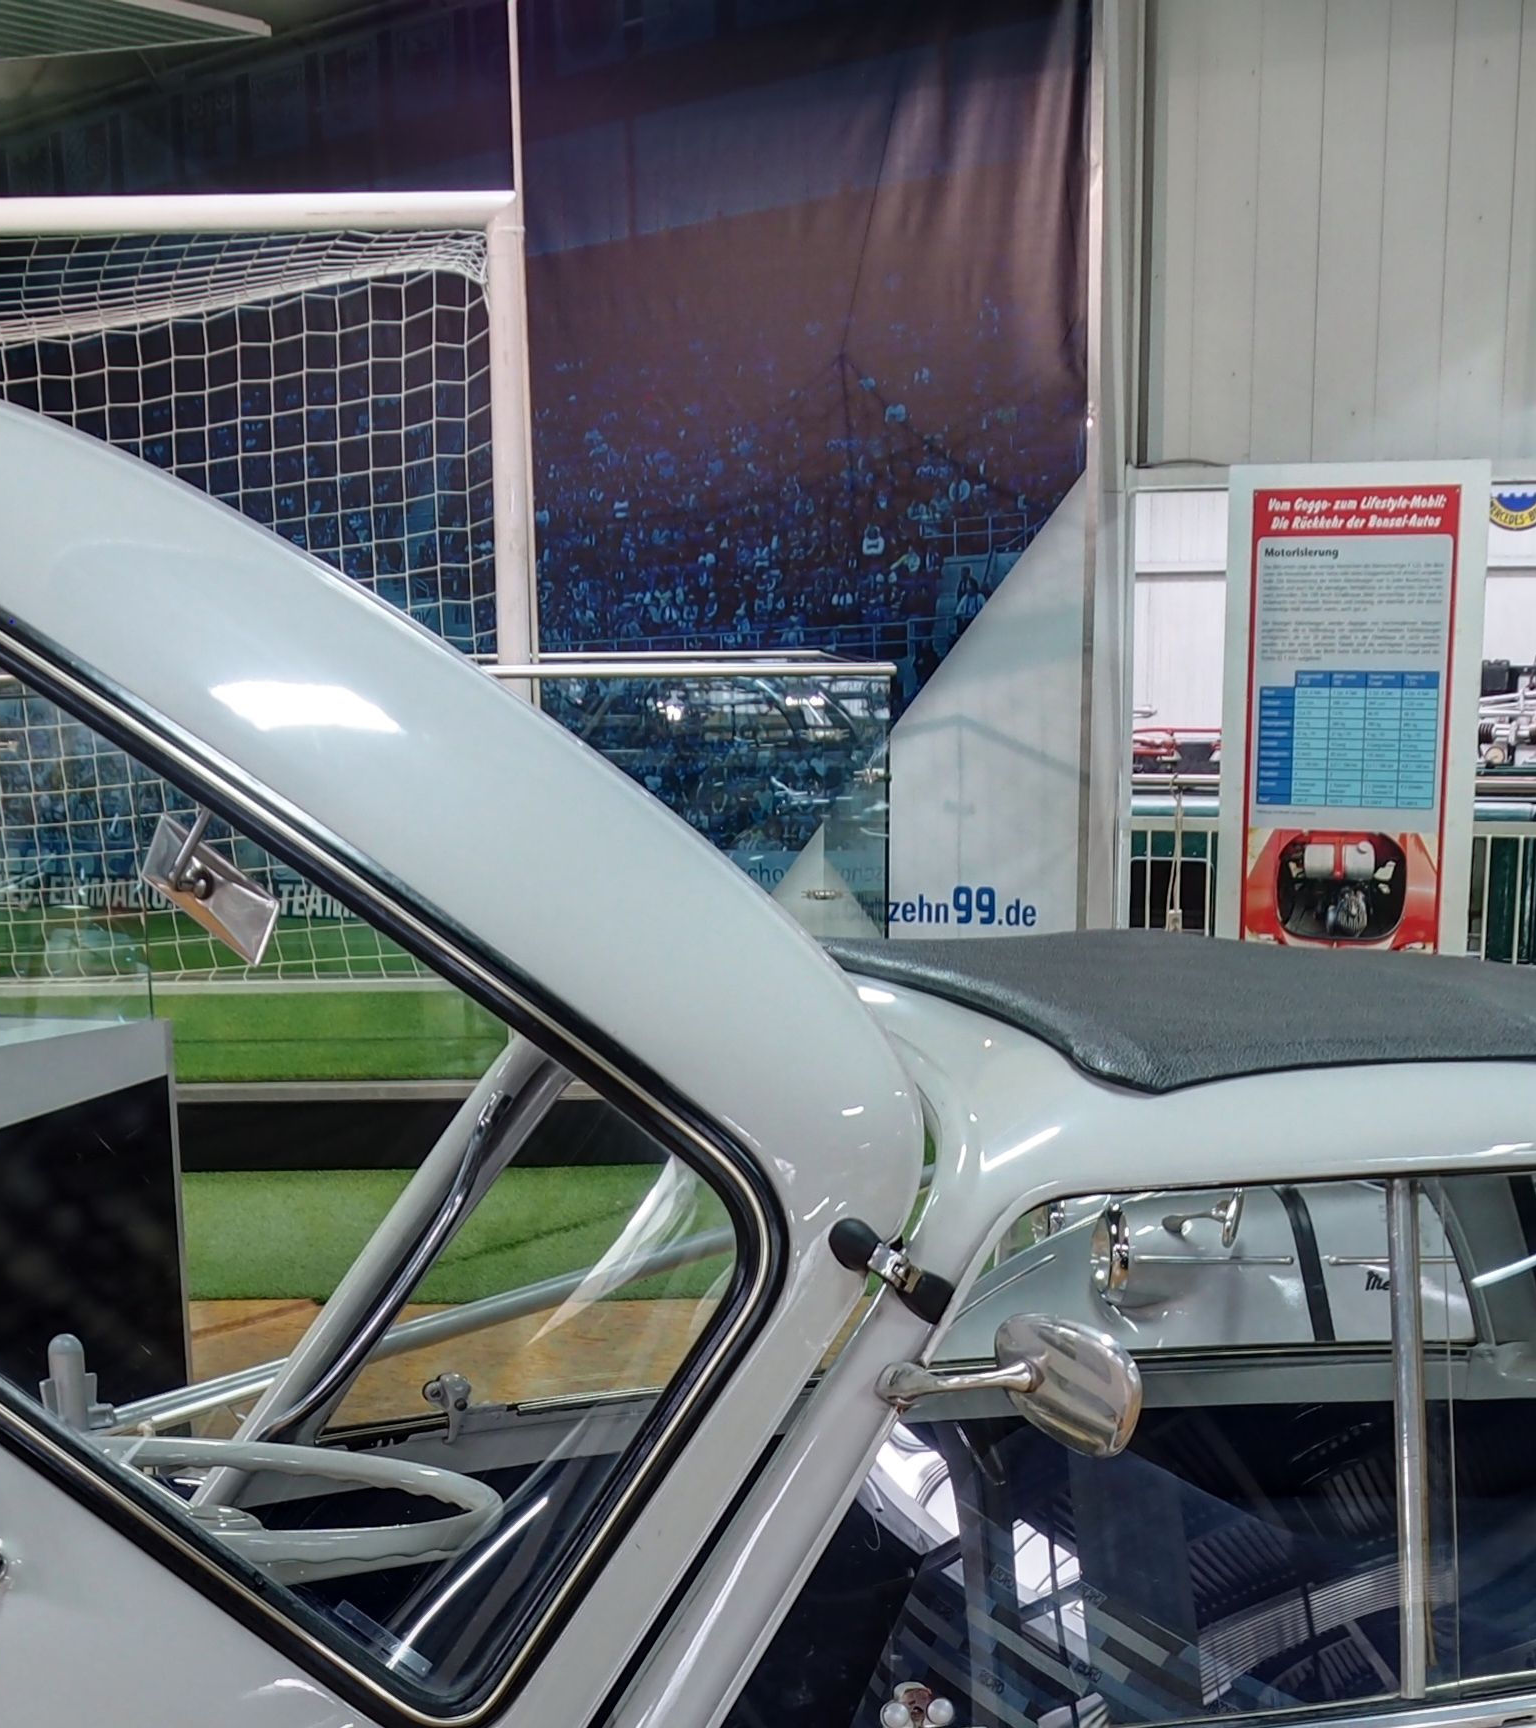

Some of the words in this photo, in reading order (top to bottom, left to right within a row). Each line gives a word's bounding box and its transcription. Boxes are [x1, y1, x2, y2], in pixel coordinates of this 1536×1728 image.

[1268, 498, 1291, 512] Vom
[1293, 497, 1331, 514] Goggo-
[1333, 498, 1358, 510] zum
[1360, 494, 1448, 513] Lifestyle-Mobil:
[1270, 516, 1289, 530] Die
[1292, 515, 1345, 529] Rückkehr
[1346, 514, 1365, 528] der
[1368, 513, 1442, 528] Bonsai-Autos
[1265, 547, 1339, 560] Motorisierung
